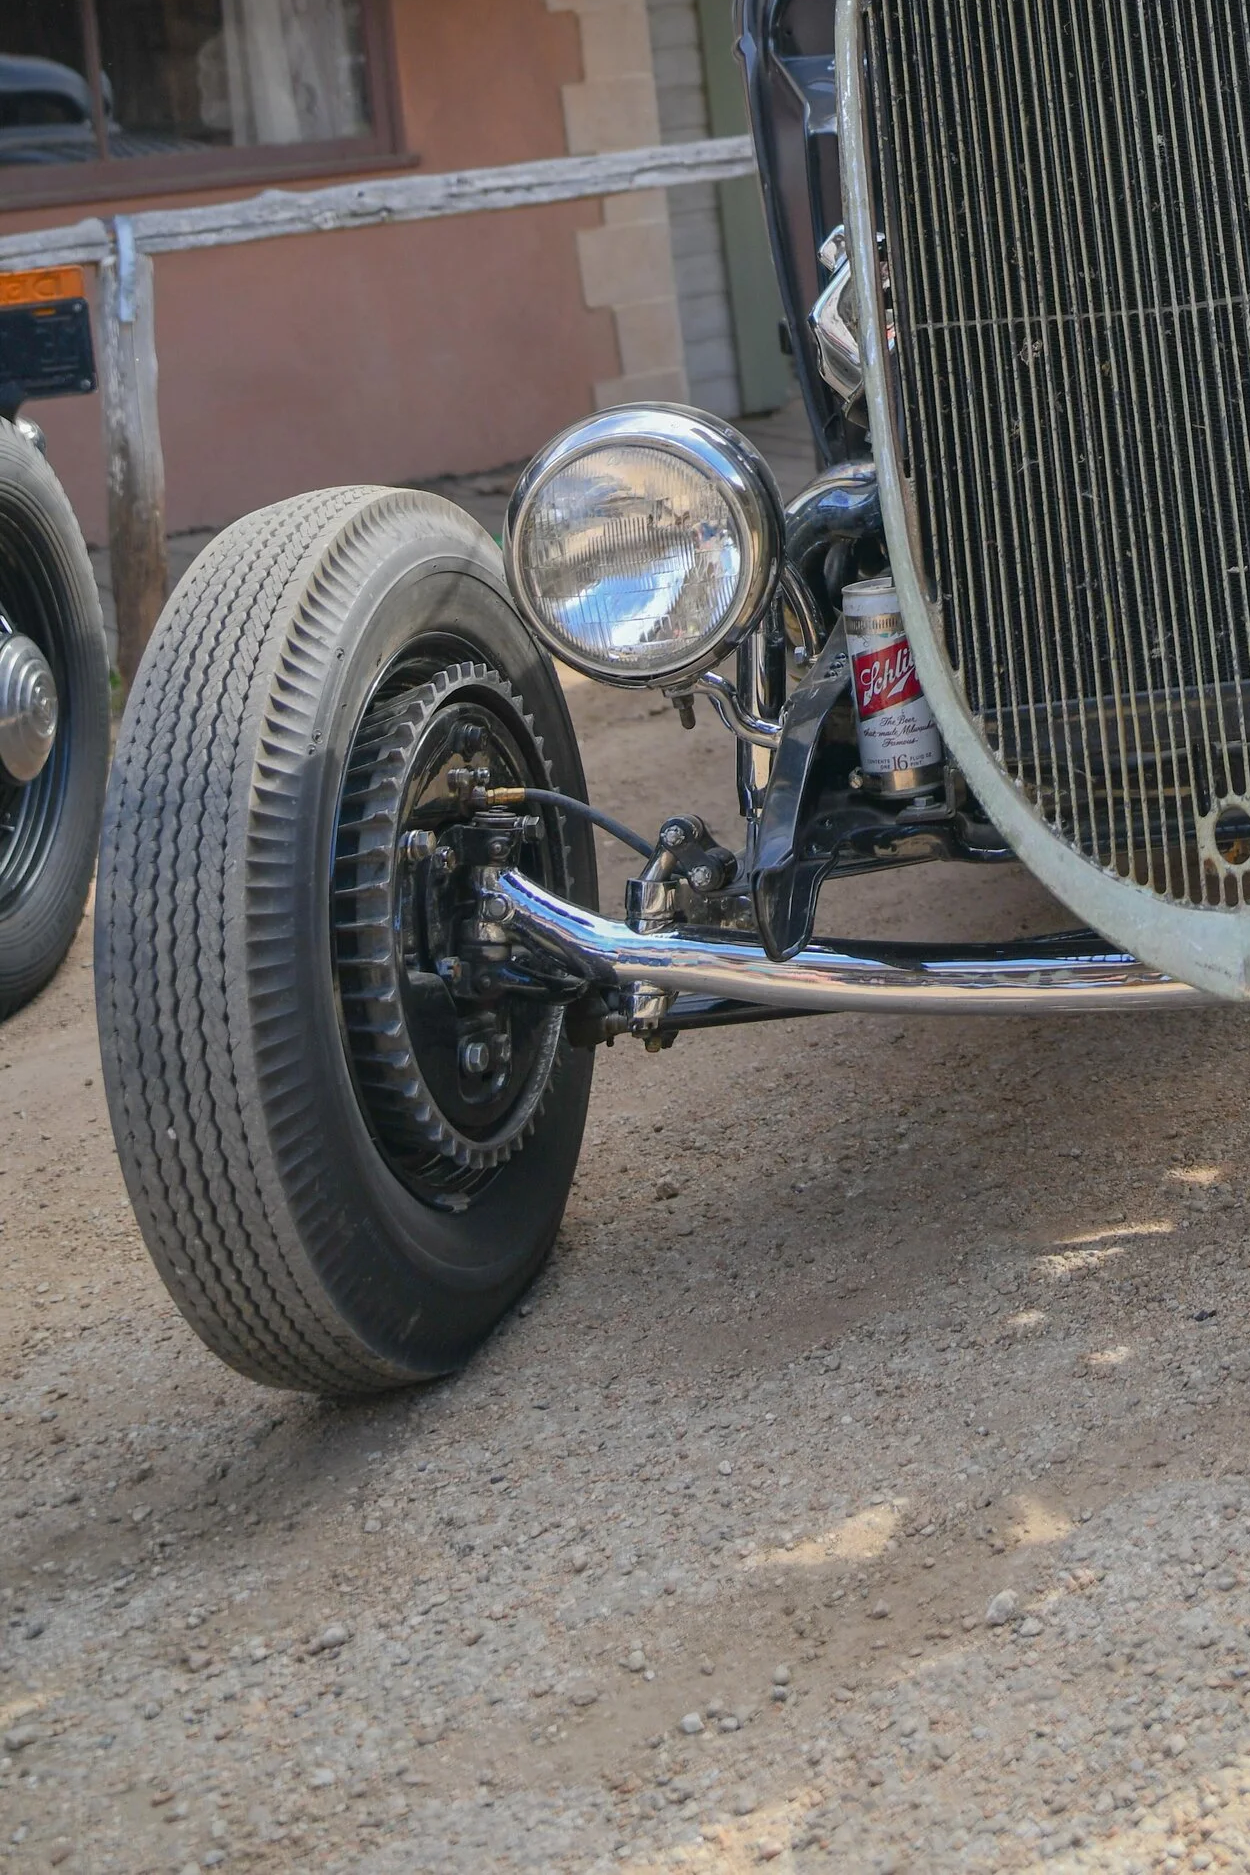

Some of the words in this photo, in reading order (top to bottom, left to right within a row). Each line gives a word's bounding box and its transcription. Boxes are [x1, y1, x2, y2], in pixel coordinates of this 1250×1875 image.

[861, 648, 920, 706] Schlit
[880, 716, 895, 727] The
[896, 714, 917, 727] Beer
[881, 736, 919, 748] Famous
[892, 753, 908, 771] 16
